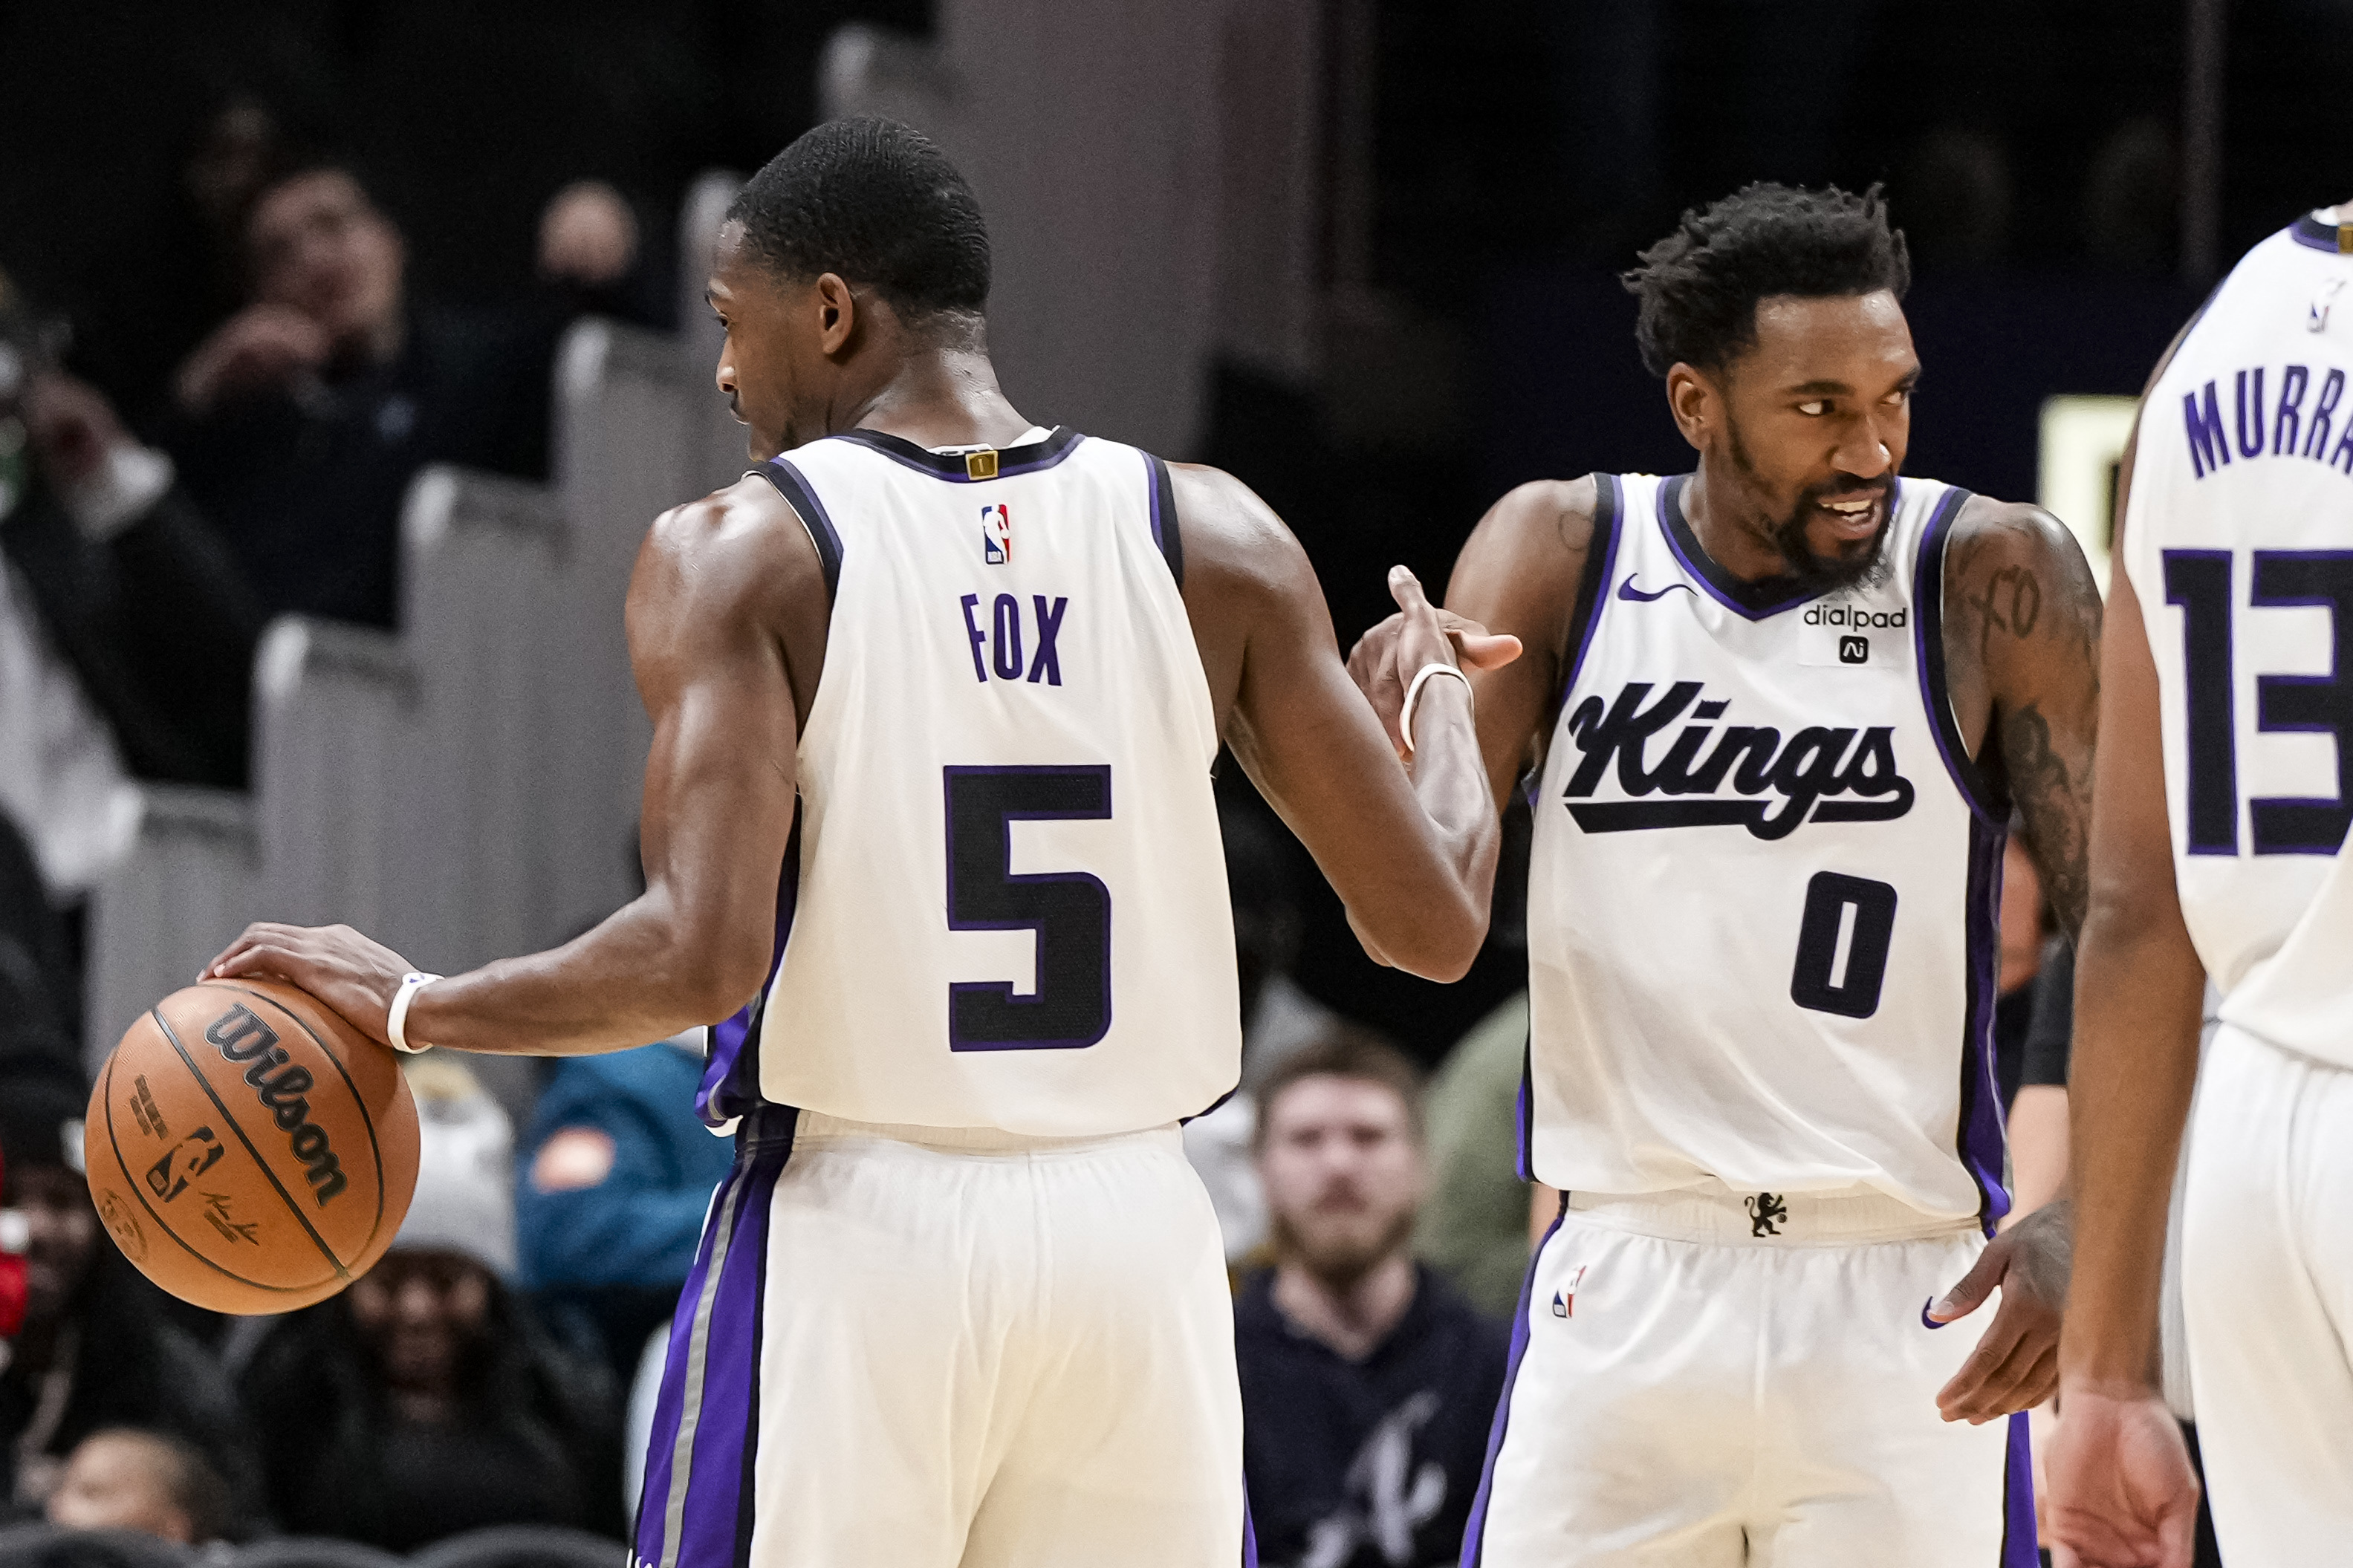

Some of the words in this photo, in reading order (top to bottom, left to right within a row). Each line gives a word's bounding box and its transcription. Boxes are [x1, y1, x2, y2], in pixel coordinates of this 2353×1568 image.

[961, 593, 1068, 686] FOX
[1804, 604, 1907, 632] dialpad
[1562, 681, 1915, 841] Kings
[2162, 550, 2353, 856] 13
[943, 764, 1113, 1052] 5
[1791, 871, 1898, 1019] 0
[204, 1001, 348, 1209] Wilson
